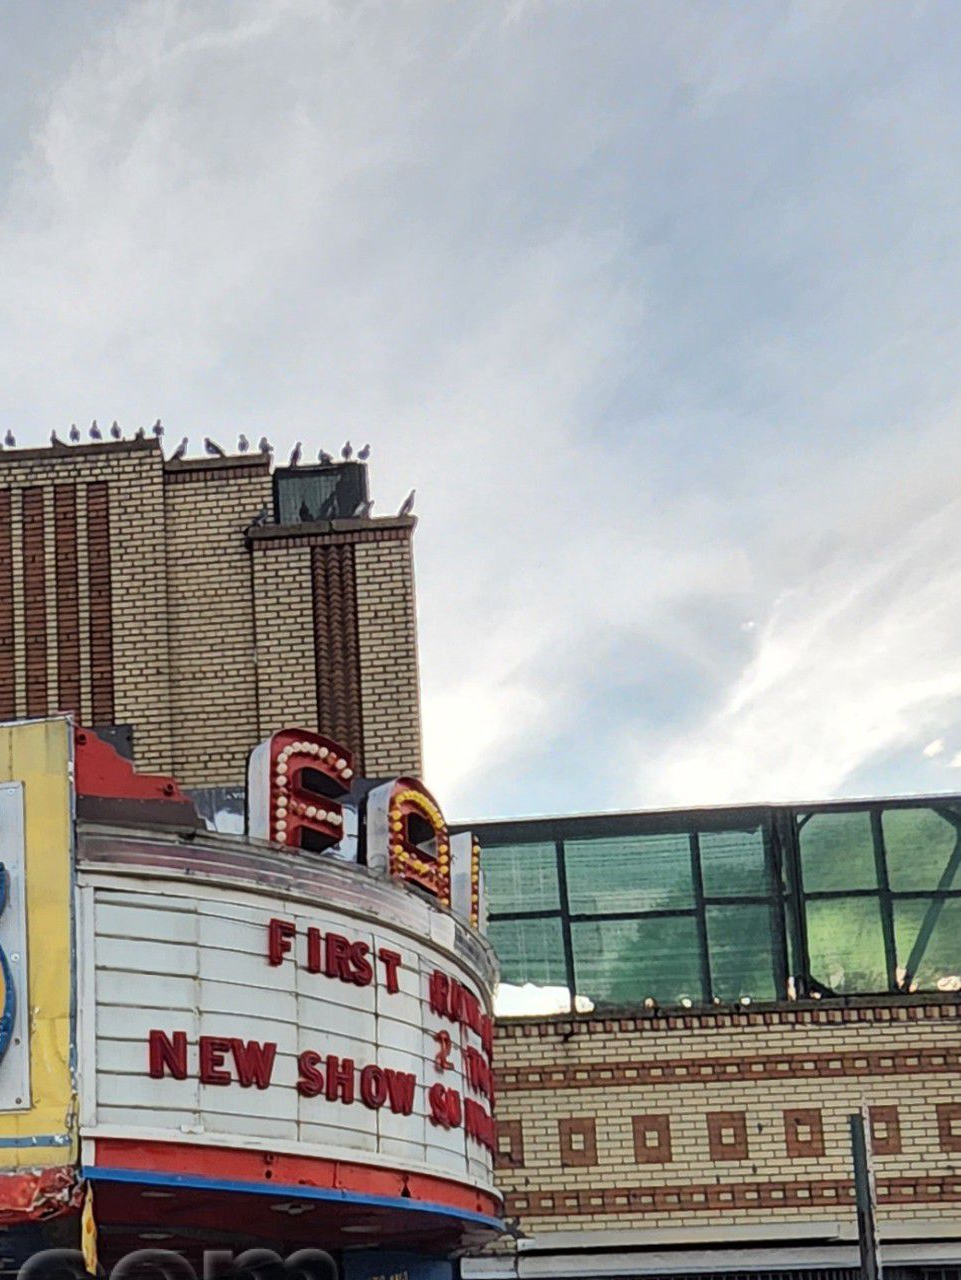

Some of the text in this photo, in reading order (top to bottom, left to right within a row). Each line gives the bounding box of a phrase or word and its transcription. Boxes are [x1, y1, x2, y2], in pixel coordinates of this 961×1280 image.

[268, 918, 402, 994] FIRST
[149, 1029, 277, 1090] NEW
[297, 1050, 416, 1116] SHOW
[434, 1030, 454, 1073] 2
